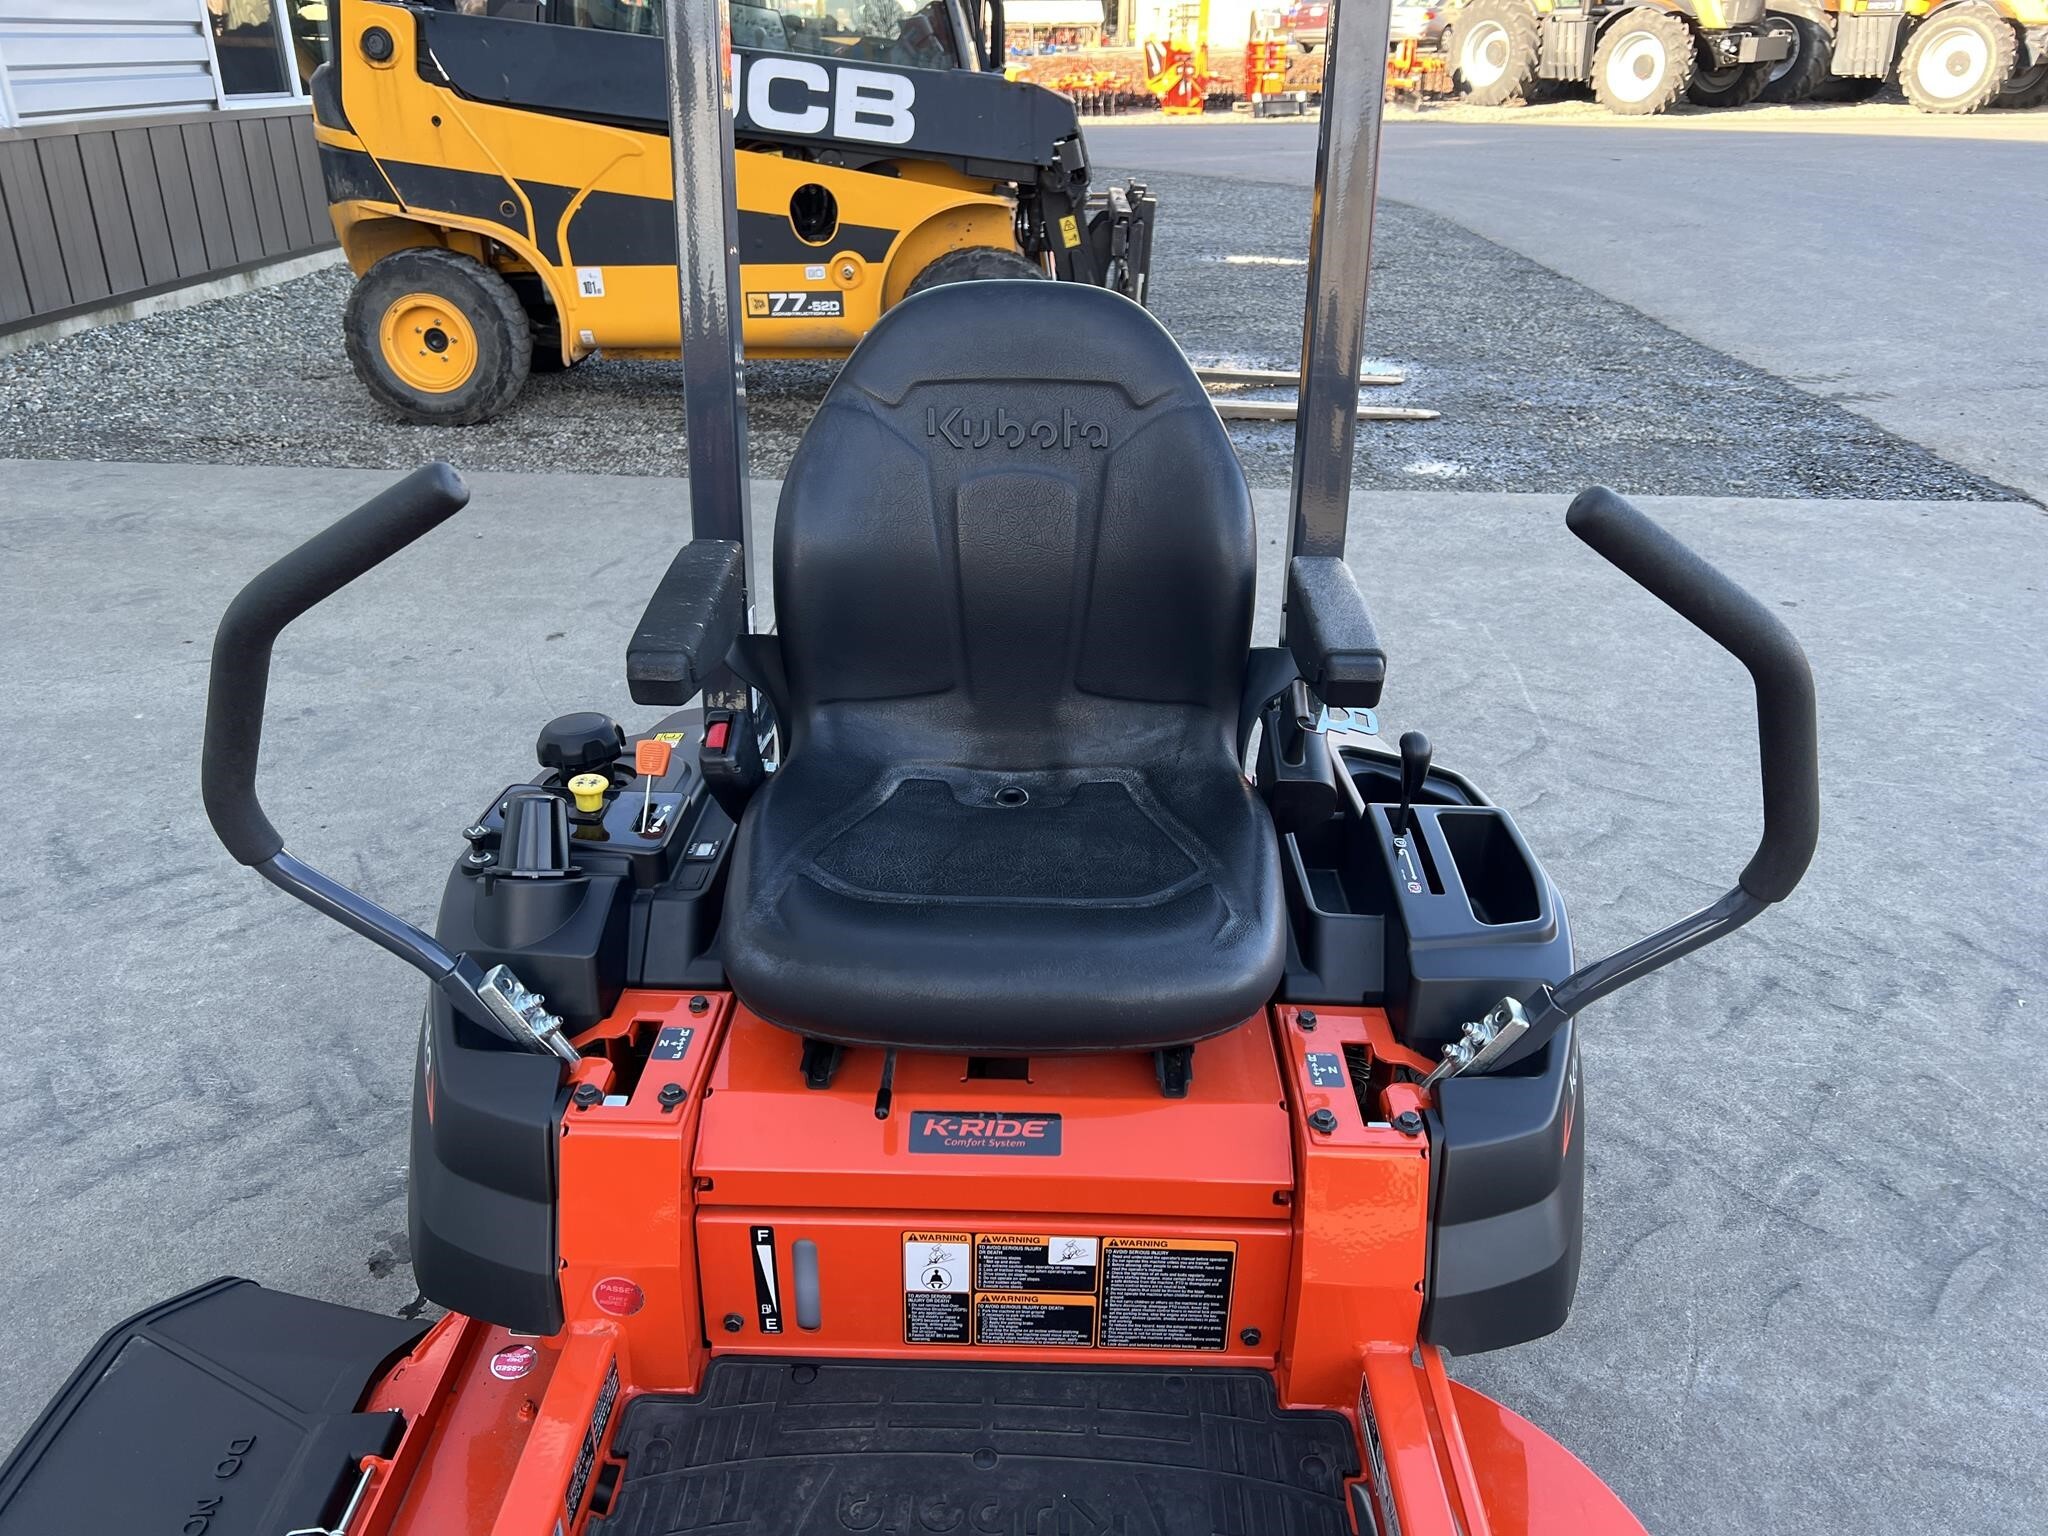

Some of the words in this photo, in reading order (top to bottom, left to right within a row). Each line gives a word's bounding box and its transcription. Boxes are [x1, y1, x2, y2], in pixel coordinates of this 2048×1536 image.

[927, 407, 1109, 449] Kubota
[680, 1029, 691, 1037] R
[659, 1039, 670, 1047] N
[671, 1051, 682, 1059] F
[1307, 1054, 1317, 1062] R
[1327, 1066, 1338, 1074] N
[1314, 1077, 1323, 1085] F
[923, 1118, 1049, 1138] K-RIDE
[944, 1138, 986, 1147] Comfort
[989, 1138, 1026, 1148] System
[757, 1230, 770, 1242] F
[1119, 1240, 1168, 1248] WARNING
[766, 1318, 778, 1330] E
[215, 1434, 257, 1479] DO
